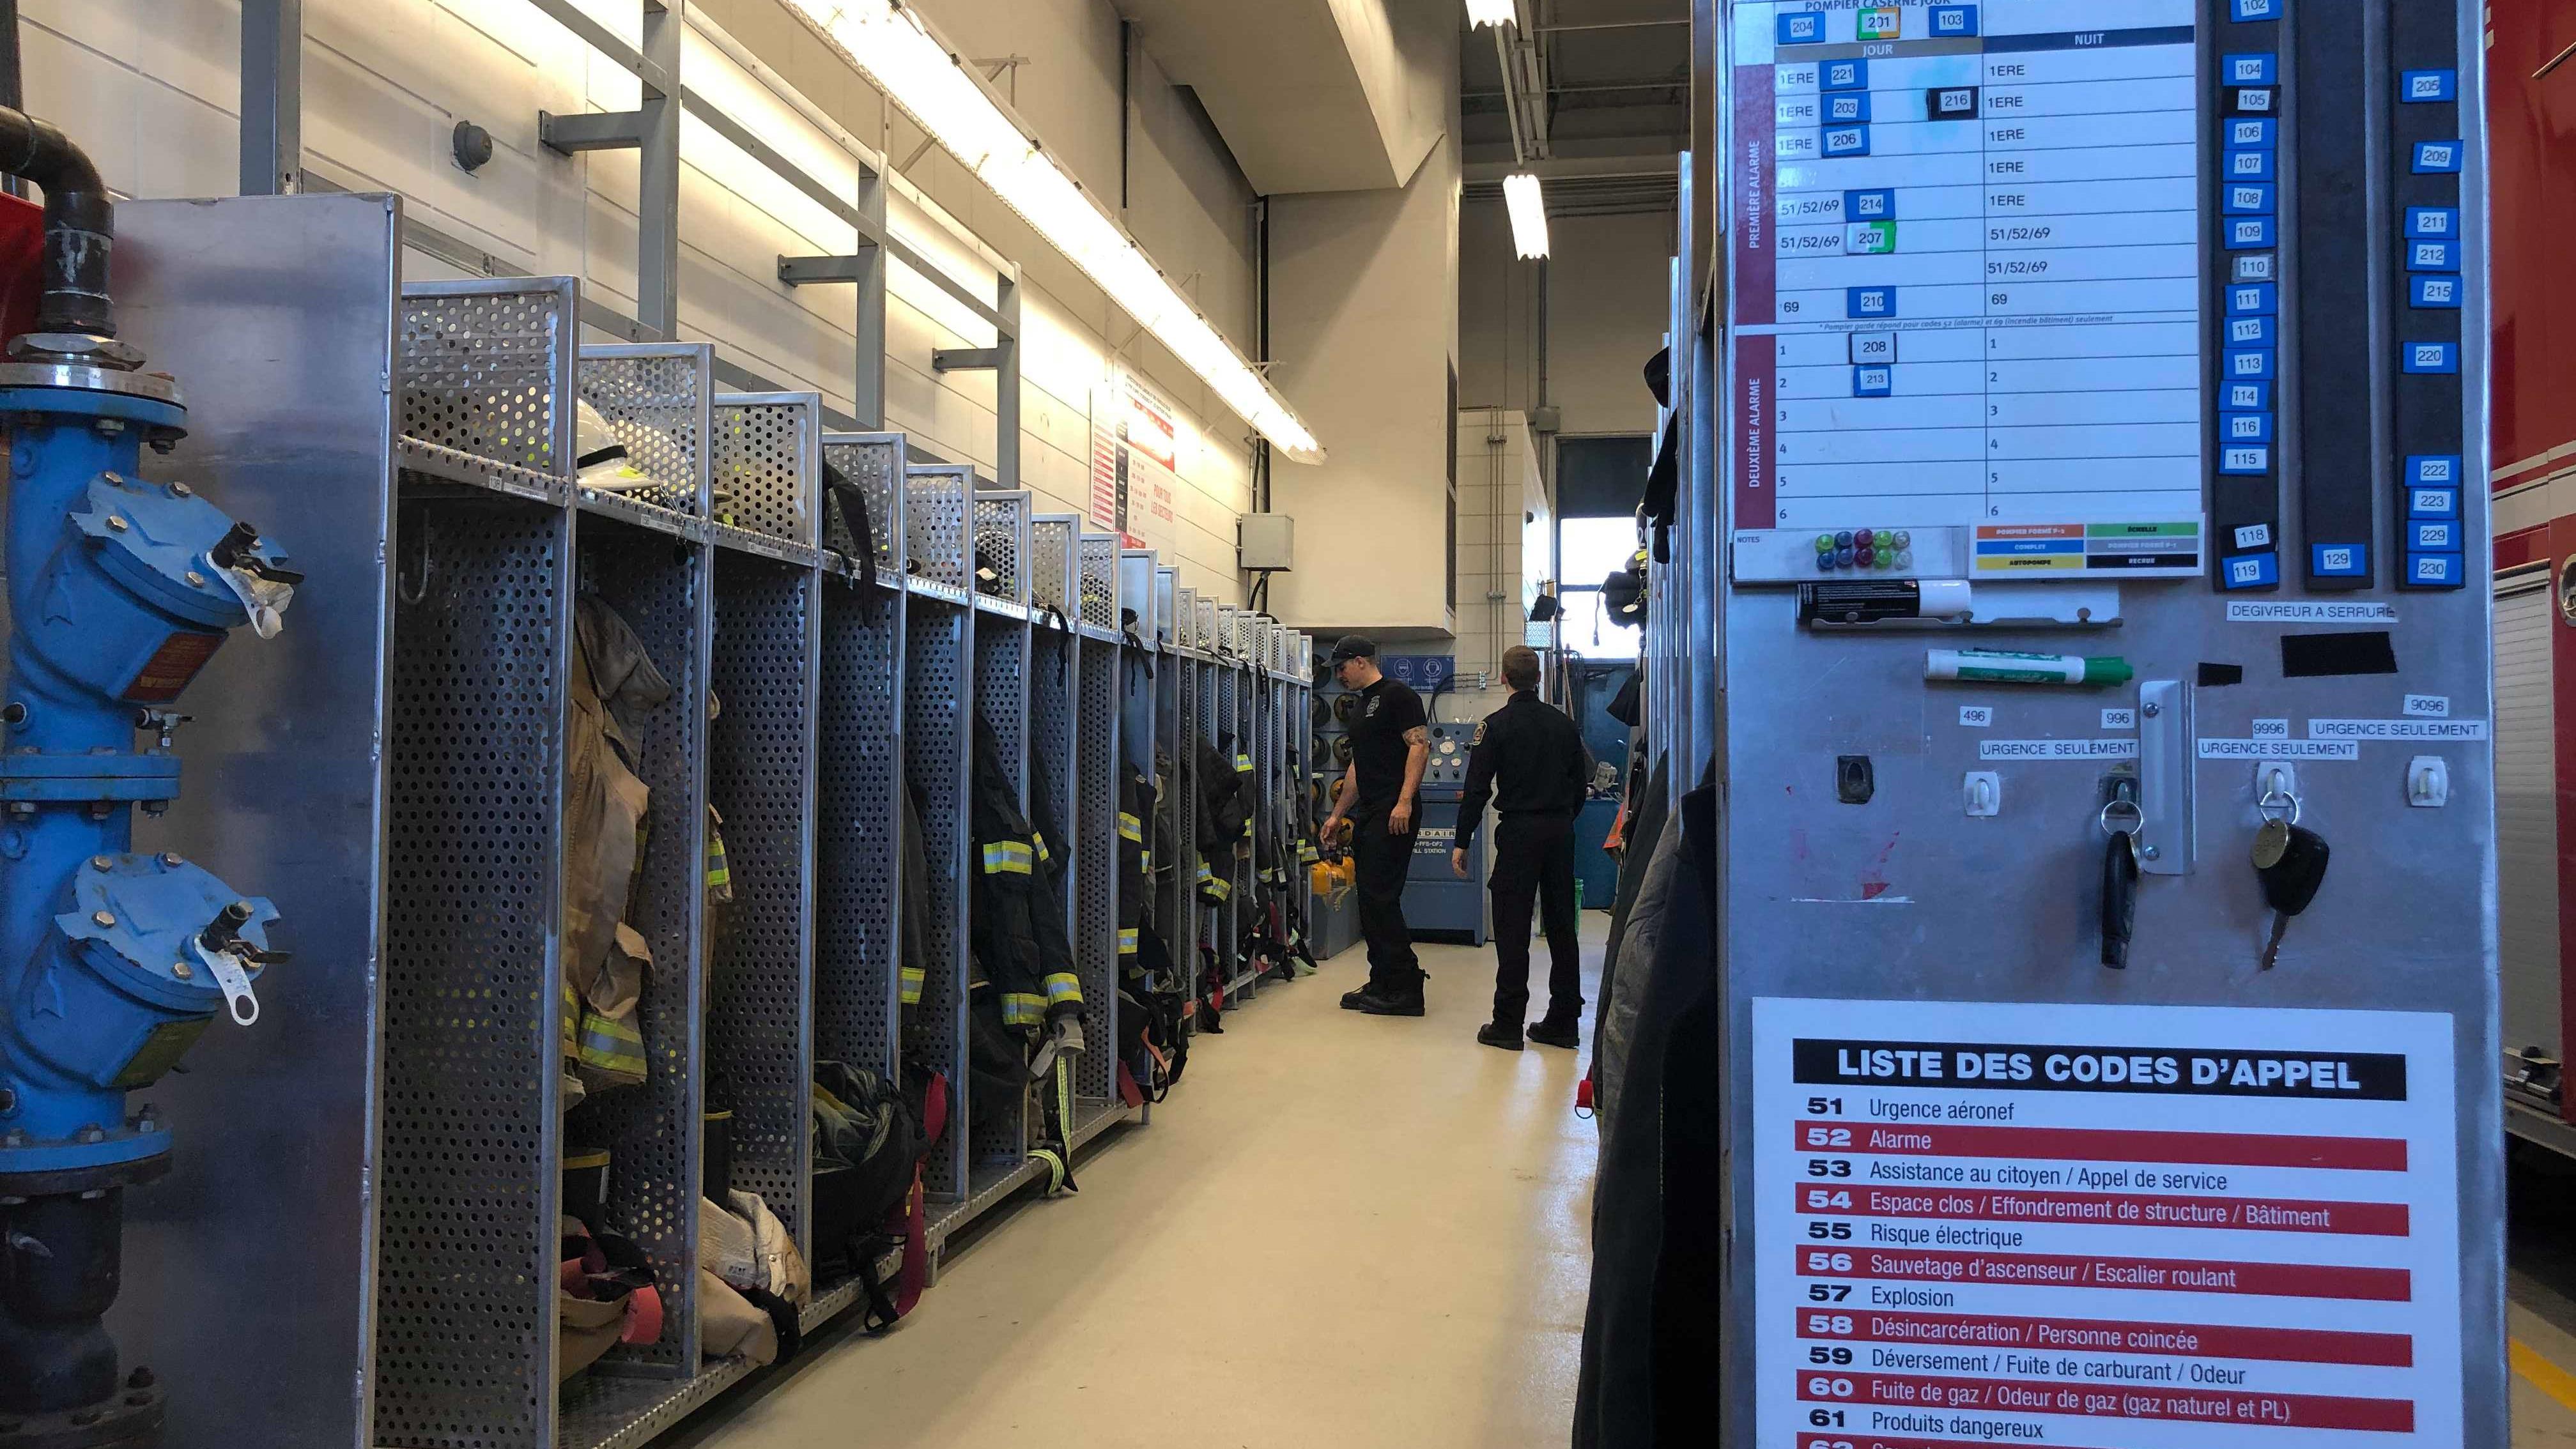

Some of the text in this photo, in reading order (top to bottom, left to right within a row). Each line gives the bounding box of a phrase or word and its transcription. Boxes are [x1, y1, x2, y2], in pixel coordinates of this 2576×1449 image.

[1805, 0, 1859, 12] POMPIER
[1868, 17, 1890, 28] 201
[1941, 14, 1962, 26] 103
[1793, 21, 1812, 33] 204
[2074, 33, 2104, 45] NUIT
[1863, 45, 1893, 56] JOUR
[1832, 68, 1853, 81] 221
[1989, 65, 2025, 77] 1ERE
[2239, 64, 2260, 74] 104
[1780, 71, 1814, 84] 1ERE
[2417, 80, 2439, 91] 205
[1945, 93, 1968, 107] 216
[1988, 96, 2023, 109] 1ERE
[2242, 95, 2265, 105] 105
[1779, 105, 1813, 118] 1ERE
[1835, 102, 1856, 114] 203
[1989, 128, 2025, 141] 1ERE
[2238, 127, 2259, 138] 106
[1778, 137, 1812, 150] 1ERE
[1833, 132, 1856, 147] 206
[2425, 151, 2447, 162] 209
[1989, 161, 2023, 173] 1ERE
[2237, 158, 2259, 169] 107
[1747, 140, 1760, 249] PREMIÈRE ALARME
[1990, 194, 2025, 206] 1ERE
[2237, 192, 2258, 204] 108
[1781, 199, 1839, 216] 51/52/69
[1861, 198, 1883, 210] 214
[2423, 217, 2444, 227] 211
[1991, 227, 2051, 240] 51/52/69
[2237, 226, 2260, 237] 109
[1781, 234, 1839, 250] 51/52/69
[1859, 233, 1882, 243] 207
[2421, 249, 2443, 260] 212
[1988, 261, 2048, 275] 51/52/69
[2241, 261, 2264, 272] 110
[2428, 286, 2449, 297] 215
[1863, 296, 1884, 307] 210
[1992, 294, 2007, 305] 69
[2238, 294, 2258, 305] 111
[2237, 325, 2258, 335] 112
[1863, 341, 1886, 353] 208
[2418, 351, 2441, 362] 220
[2239, 358, 2260, 369] 113
[1867, 374, 1884, 384] 213
[2235, 391, 2255, 401] 114
[1747, 378, 1760, 488] DEUXIÈME ALARME
[2235, 422, 2256, 432] 116
[2234, 454, 2256, 464] 115
[2423, 465, 2446, 476] 222
[2421, 496, 2444, 507] 223
[2242, 529, 2264, 541] 118
[2422, 530, 2445, 541] 229
[2326, 554, 2348, 564] 129
[2235, 565, 2256, 576] 119
[2421, 564, 2443, 574] 230
[2232, 606, 2395, 618] DEGIVREUR A SERRURE
[2411, 699, 2444, 712] 9096
[1964, 710, 1986, 722] 496
[2107, 712, 2129, 724] 996
[2253, 723, 2285, 735] 9996
[2316, 723, 2478, 735] URGENCE SEULEMENT
[1982, 742, 2134, 755] URGENCE SEULEMENT
[2202, 743, 2355, 755] URGENCE SEULEMENT
[1839, 1049, 2360, 1089] LISTE DES CODES D'APPEL
[1808, 1098, 2014, 1121] 51 Urgence aéronef
[1807, 1128, 1931, 1149] 52 Alarme
[1808, 1160, 2227, 1190] 53 Assistance au citoyen Appel de service
[1808, 1191, 2329, 1227] 54 Espace clos Effondrement de structure Bâtiment
[1809, 1222, 2022, 1249] 55 Risque électrique
[1809, 1254, 2235, 1287] 56 Sauvetage d'ascenseur Escalier roulant
[1809, 1284, 1954, 1309] 57 Explosion
[1809, 1315, 2198, 1351] 58 Désincarcération Personne coincée
[1809, 1347, 2245, 1384] 59 Déversement Fuite de carburant Odeur
[1809, 1379, 2290, 1423] 60 Fuite de gaz Odeur de gaz (gaz naturel et PL)
[1809, 1409, 2043, 1439] 61 Produits dangereux
